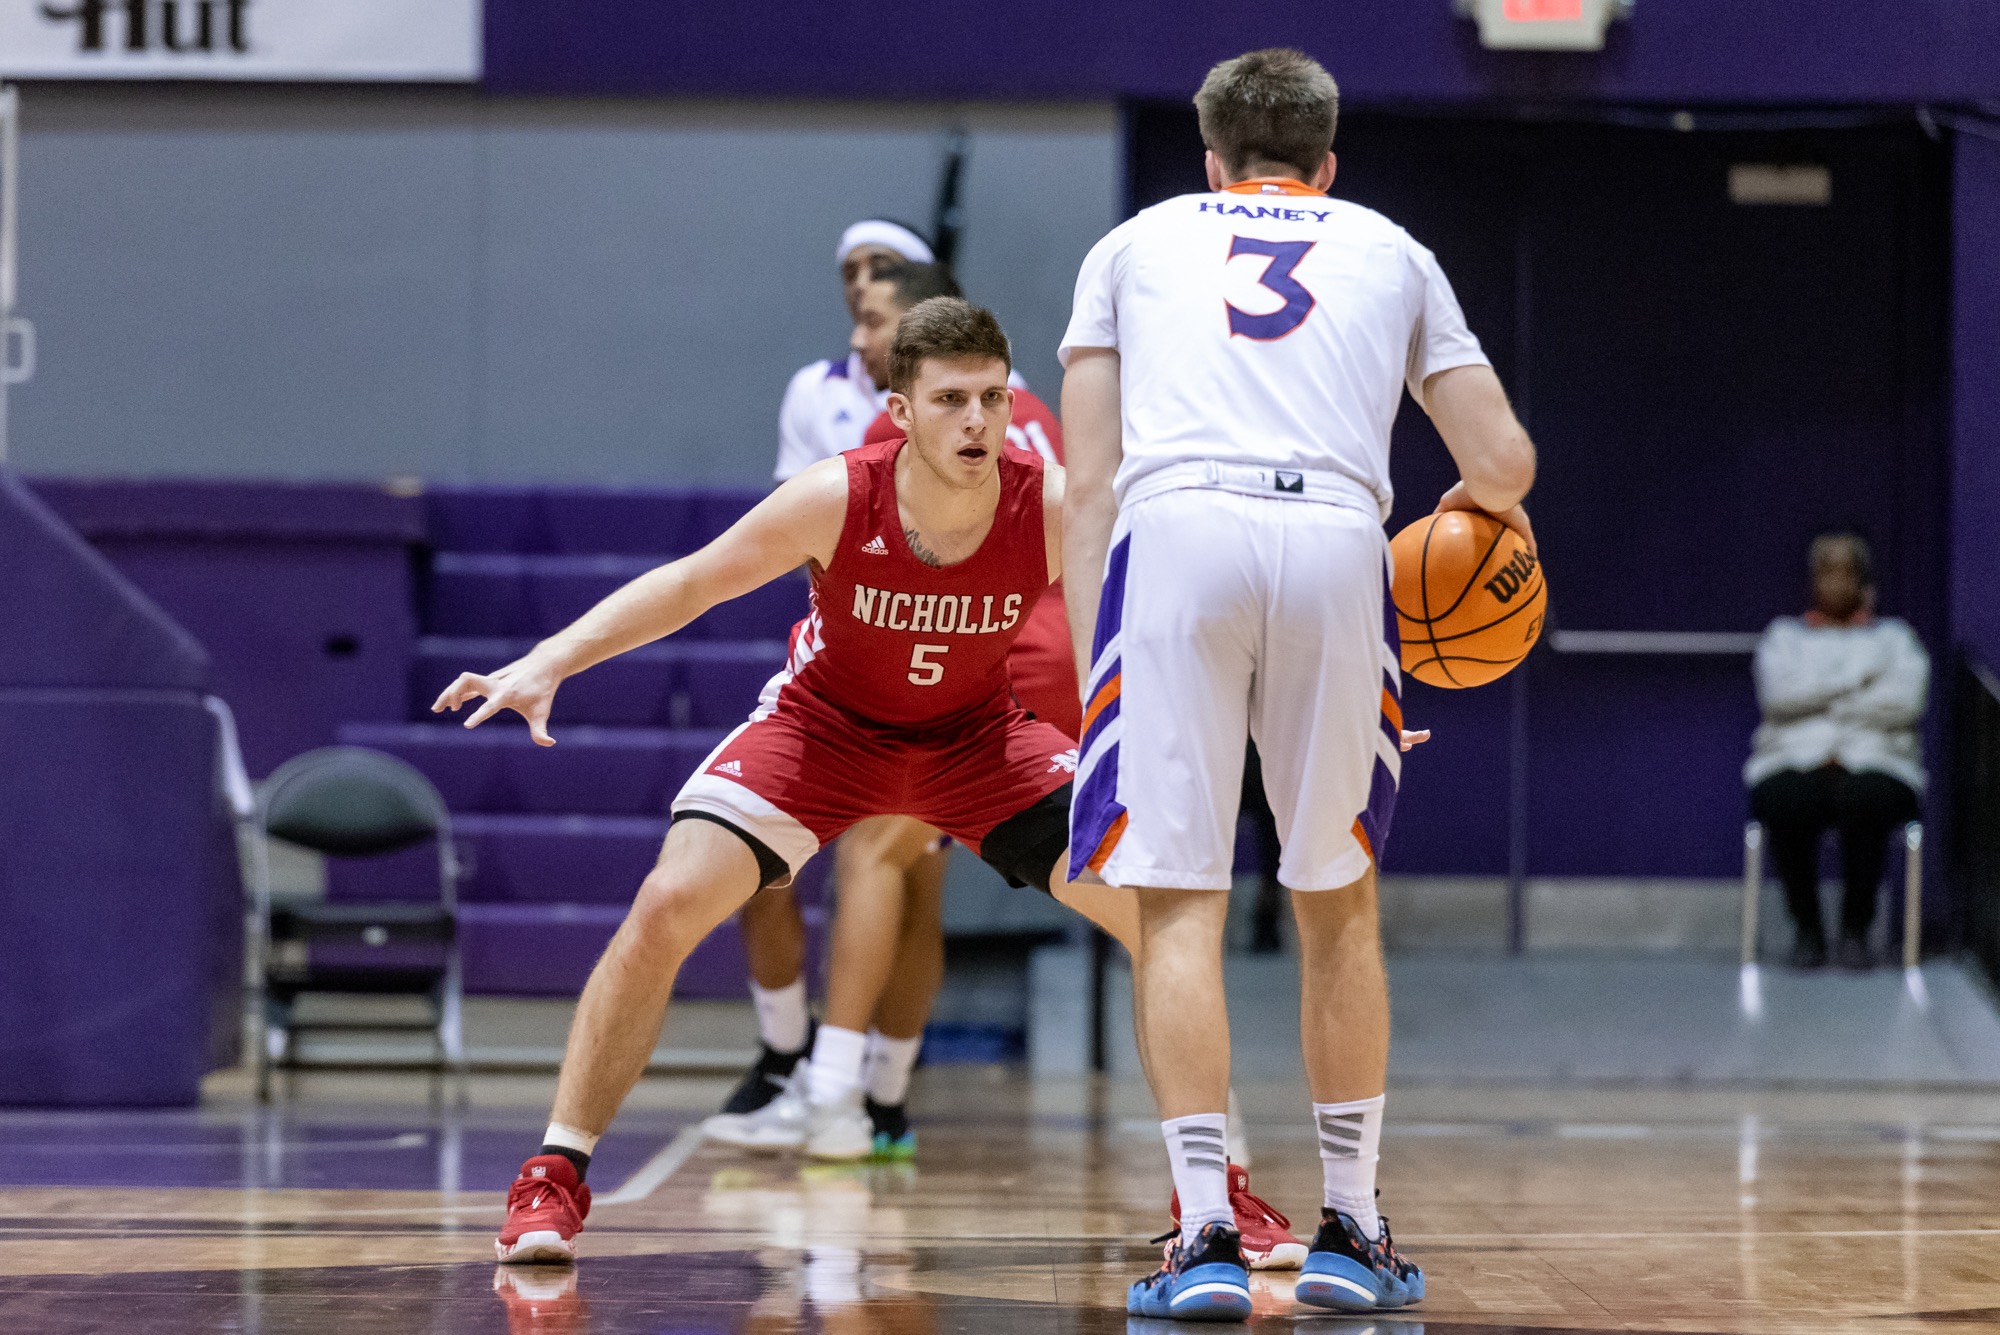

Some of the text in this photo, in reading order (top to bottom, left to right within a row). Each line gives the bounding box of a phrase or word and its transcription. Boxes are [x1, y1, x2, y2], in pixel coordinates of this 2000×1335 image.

[1199, 202, 1335, 223] HANEY
[1223, 233, 1318, 342] 3
[861, 546, 889, 556] adidas
[851, 583, 1023, 635] NICHOLLS
[907, 643, 950, 686] 5
